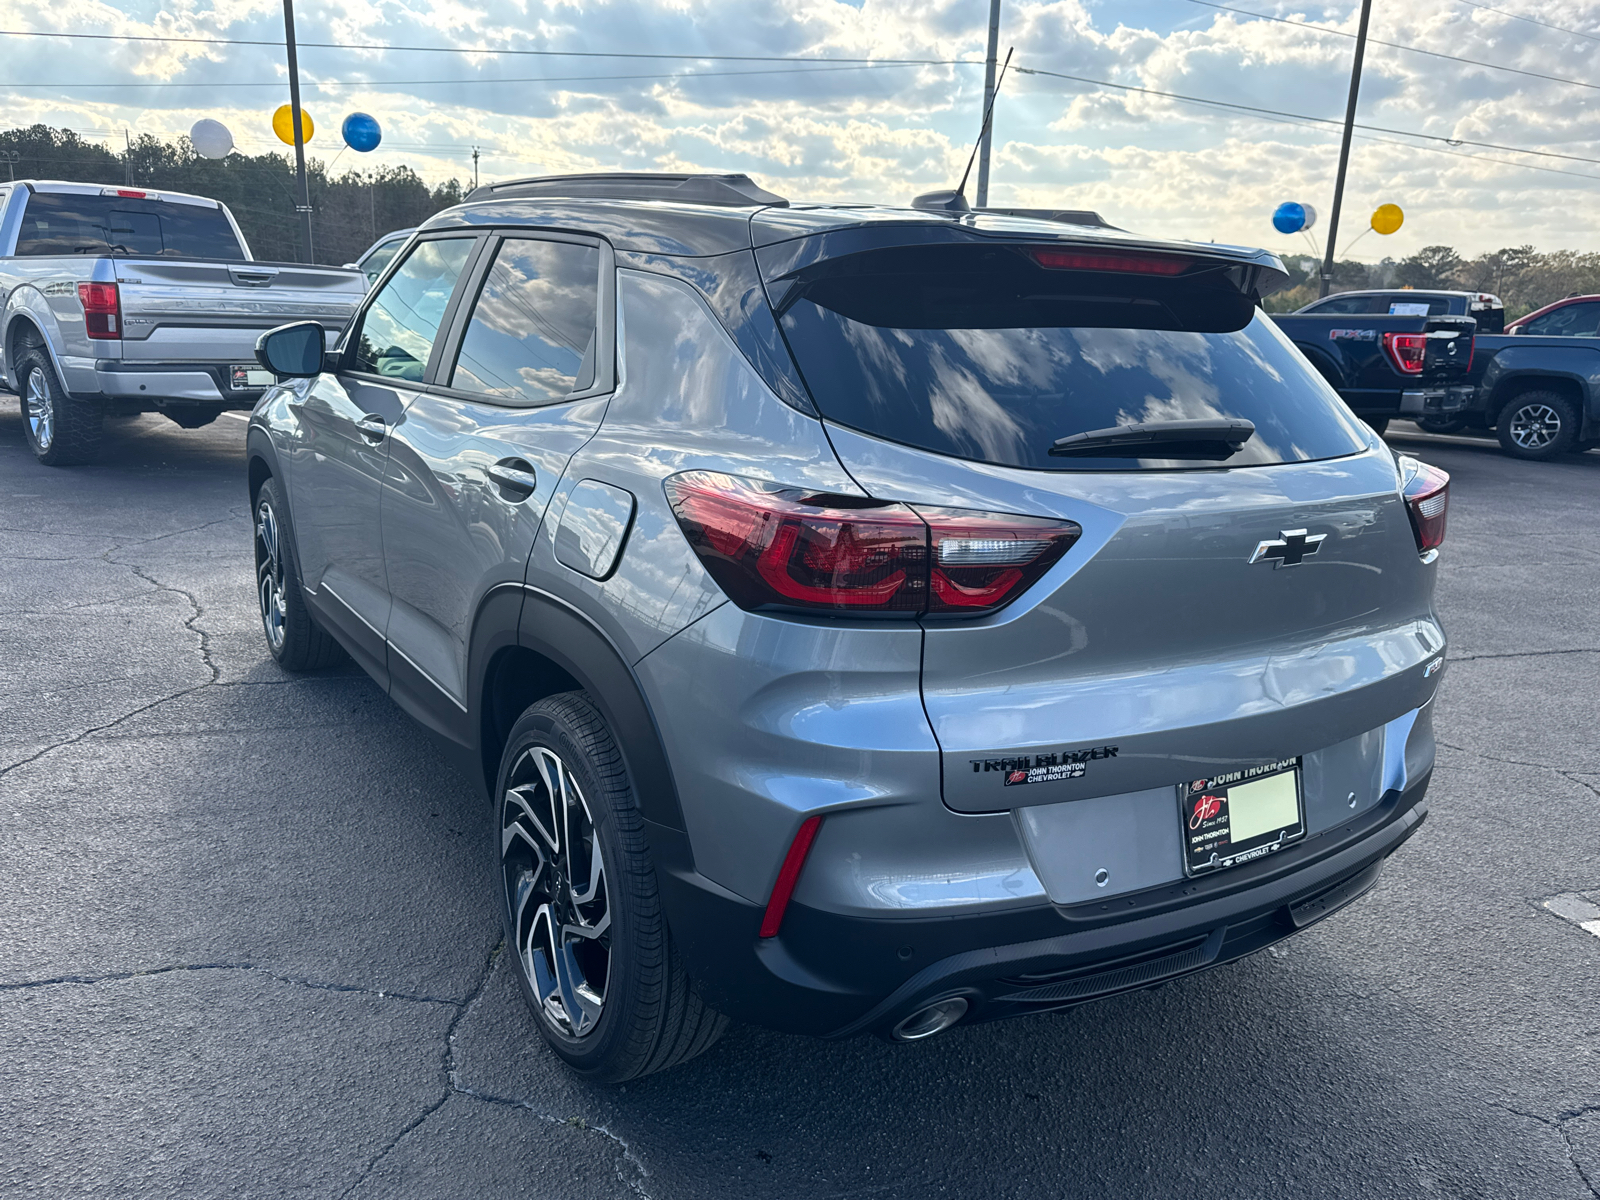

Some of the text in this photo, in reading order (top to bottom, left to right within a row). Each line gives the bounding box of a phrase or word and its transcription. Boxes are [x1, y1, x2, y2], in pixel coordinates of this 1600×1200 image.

[969, 744, 1119, 773] TRAILBLAZER
[1027, 771, 1071, 783] CHEVROLET
[1028, 763, 1085, 777] JOHN THORNTON
[1212, 771, 1241, 786] JOHN
[1192, 828, 1229, 844] JOHN THORNTON
[1235, 847, 1270, 864] CHEVROLET
